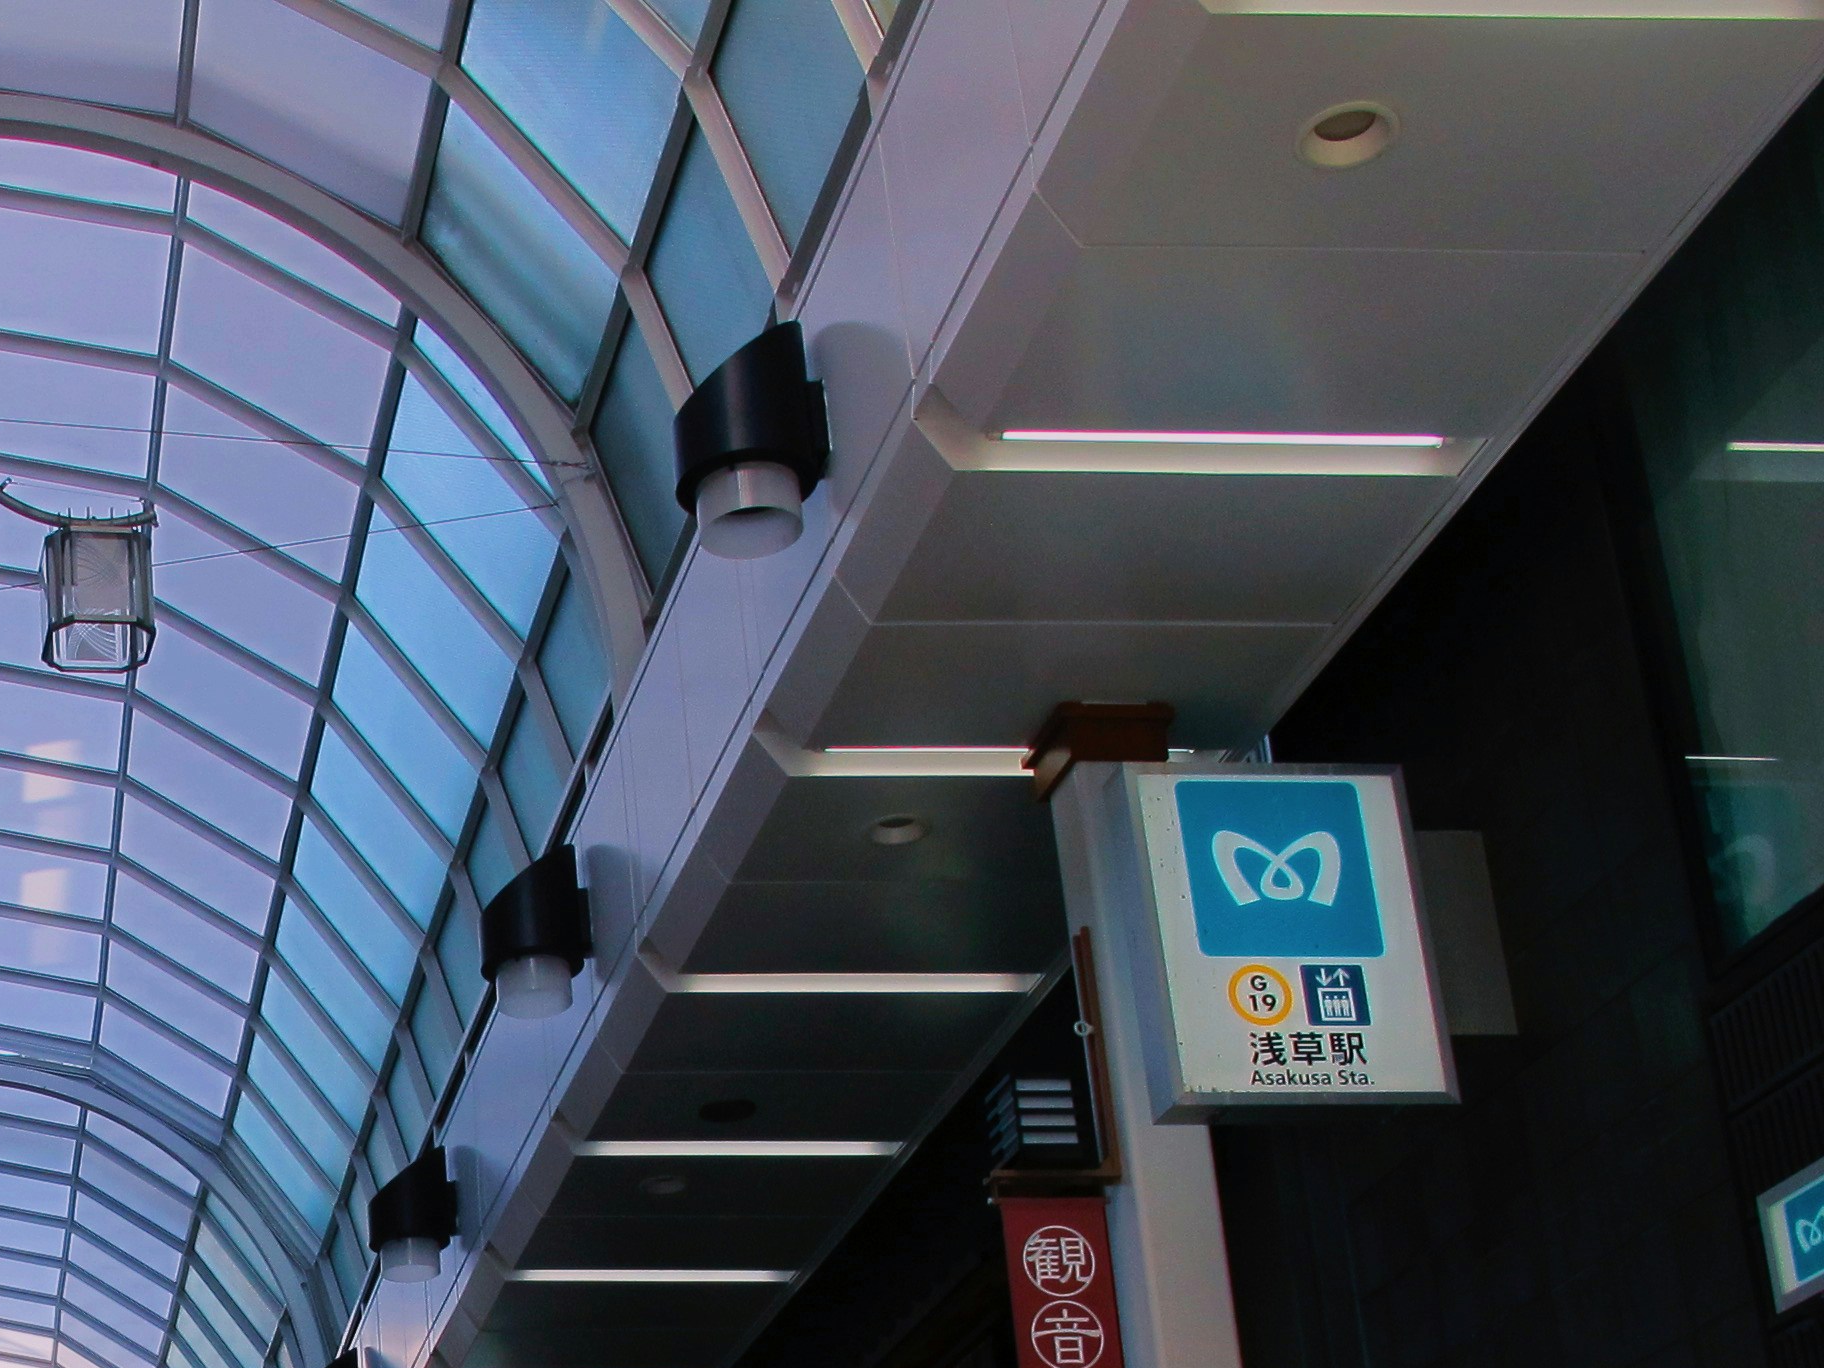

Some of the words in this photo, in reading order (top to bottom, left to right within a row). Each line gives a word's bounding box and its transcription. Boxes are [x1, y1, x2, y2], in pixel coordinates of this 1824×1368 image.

[1250, 974, 1267, 992] G
[1248, 994, 1276, 1012] 19
[1249, 1031, 1368, 1066] 浅草駅
[1250, 1069, 1332, 1087] Asakusa
[1339, 1070, 1375, 1086] Sta.
